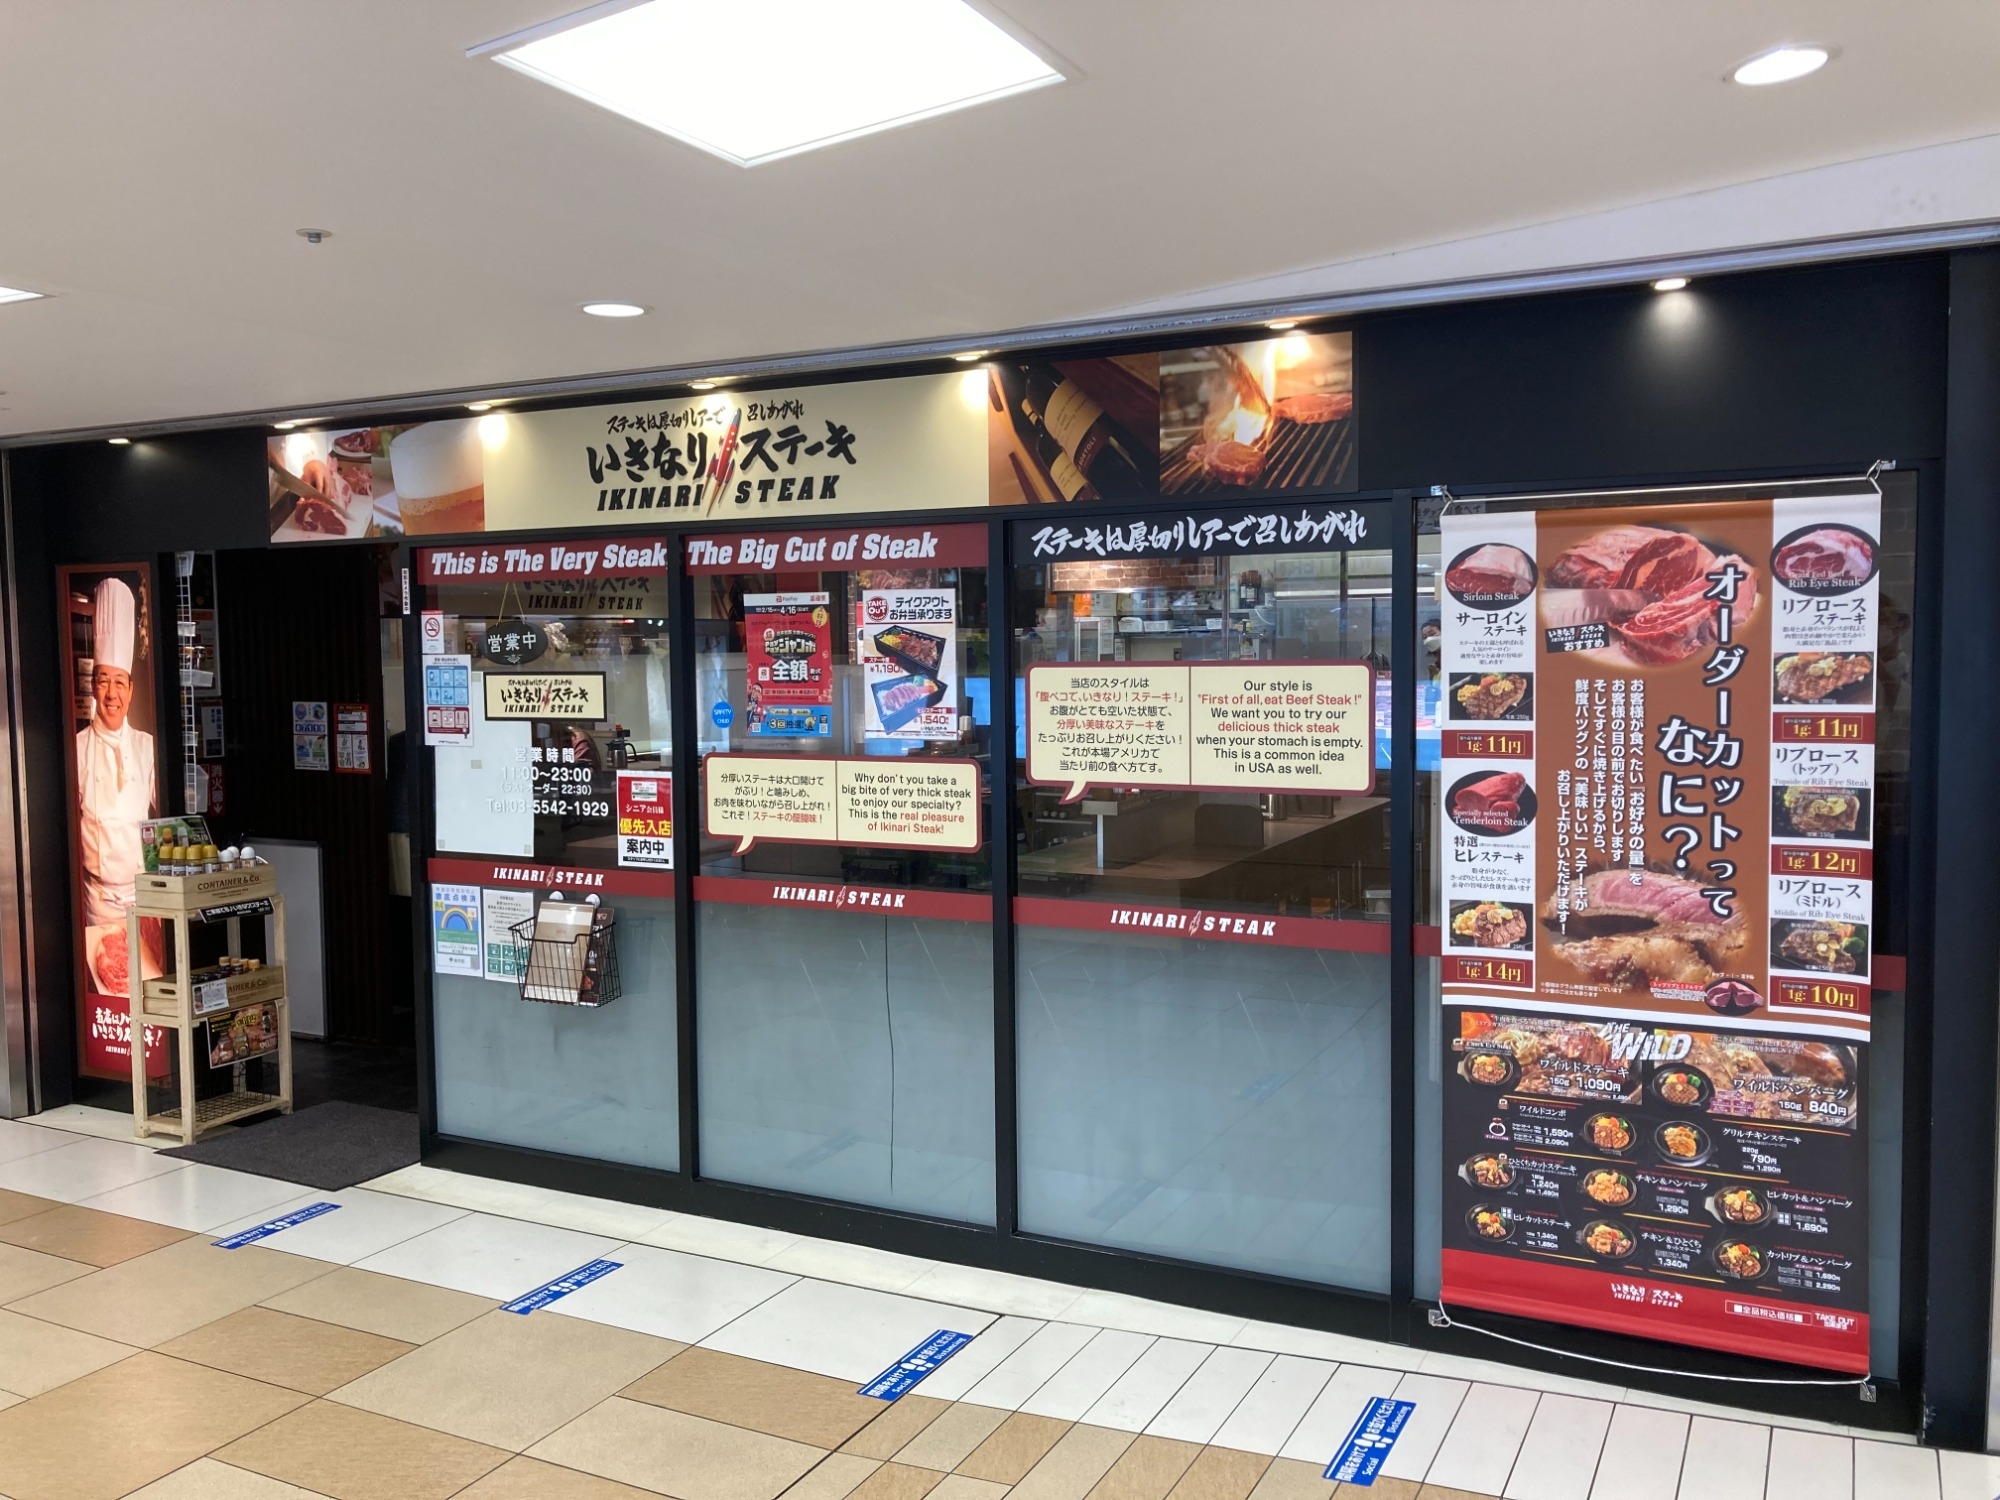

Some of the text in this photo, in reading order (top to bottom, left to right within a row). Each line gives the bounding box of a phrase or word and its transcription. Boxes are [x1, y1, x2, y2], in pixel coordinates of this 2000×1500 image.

[607, 398, 804, 435] ステーキは厚切りレアーで 召しあがれ
[586, 419, 857, 484] いきなり ステーキ
[597, 474, 840, 512] IKINARI STEAK
[688, 531, 938, 570] The Big Cut of Steak
[431, 542, 668, 575] This is The Very Steak
[1789, 577, 1861, 589] Rib Eye Steak
[528, 595, 644, 610] IKINARI STEAK
[896, 596, 950, 608] テイクアウト
[1463, 592, 1519, 601] Sirloin Steak
[889, 609, 952, 621] お弁当承ります
[1455, 611, 1528, 626] サーロイン
[1812, 613, 1866, 626] ステーキ
[1483, 625, 1527, 637] ステーキ
[487, 631, 537, 653] 営業中
[1564, 638, 1605, 652] おすすめ
[772, 660, 809, 681] 全額
[1070, 677, 1150, 689] 当店のスタイルは
[1243, 680, 1312, 693] Our style is
[500, 686, 589, 703] いきなり ステーキ
[1232, 693, 1243, 705] of
[1265, 695, 1282, 706] eat
[1286, 694, 1314, 705] Beef
[504, 704, 584, 713] IKINARI STEAK
[1049, 705, 1173, 717] お腹がとても空いた状態で、
[1211, 708, 1347, 721] We want you to try our
[1056, 718, 1165, 731] 分厚い美味なステーキを
[1218, 721, 1340, 733] delicious thick steak
[1816, 718, 1858, 738] 11円
[1196, 735, 1364, 749] when your stomach is empty.
[1467, 735, 1522, 754] 1g: 11円
[1702, 565, 1748, 918] オーダーカットって
[515, 747, 575, 764] 営業時間
[1061, 747, 1160, 759] これが本場アメリカで
[1213, 748, 1345, 762] This is a common idea
[1775, 747, 1859, 765] リブロース
[1059, 760, 1164, 774] 当たり前の食べ方です。
[1235, 762, 1323, 775] in USA as well.
[1592, 678, 1607, 854] そしてすぐに焼き上げるから、
[1611, 678, 1625, 862] お客様の目の前でお切りします
[720, 773, 825, 786] 分厚いステーキは大口開けて
[854, 773, 957, 787] Why don't you take a
[1811, 778, 1869, 788] Rib Eye Steak
[841, 784, 971, 799] big bite of very thick steak
[1574, 678, 1590, 912] 鮮度バツグンの「美味しい」ステーキが
[1656, 716, 1708, 870] なに？
[486, 798, 609, 818] Tel:03-5542-1929
[626, 803, 665, 814] シニア会員様
[851, 798, 962, 812] to enjoy our specialty?
[849, 809, 965, 824] This is the real pleasure
[1453, 809, 1508, 818] Specially selected
[1453, 815, 1529, 827] Tenderloin Steak
[619, 817, 671, 837] 優先入店
[867, 822, 944, 834] of Ikinari Steak!
[626, 838, 664, 856] 案内中
[1454, 835, 1478, 847] 特選
[1454, 849, 1524, 864] ヒレステーキ
[1811, 851, 1856, 873] 12円
[197, 877, 243, 890] CONTAINER
[493, 867, 605, 886] IKINARI STEAK
[773, 886, 906, 908] IKINARI STEAK
[1779, 879, 1861, 900] リブロース
[1110, 909, 1277, 936] IKINARI STEAK
[1774, 909, 1798, 917] Middle
[1808, 910, 1823, 918] Rib
[1825, 911, 1840, 920] Eye
[1843, 912, 1866, 922] Steak
[1484, 961, 1521, 982] 14円
[1811, 986, 1854, 1007] 10円
[1540, 1059, 1630, 1078] ワイルドステーキ
[1576, 1076, 1621, 1092] 1,090円
[1733, 1079, 1849, 1100] ワイルドハンバーグ
[1520, 1105, 1567, 1117] ワイルドコンボ
[1809, 1100, 1847, 1116] 840円
[1723, 1127, 1802, 1145] グリルチキンステーキ
[1611, 1283, 1683, 1303] いきなり ステーキ
[1815, 1312, 1836, 1321] TAKE
[1837, 1316, 1855, 1326] OUT
[891, 1378, 913, 1393] Social
[1361, 1457, 1380, 1476] Social
